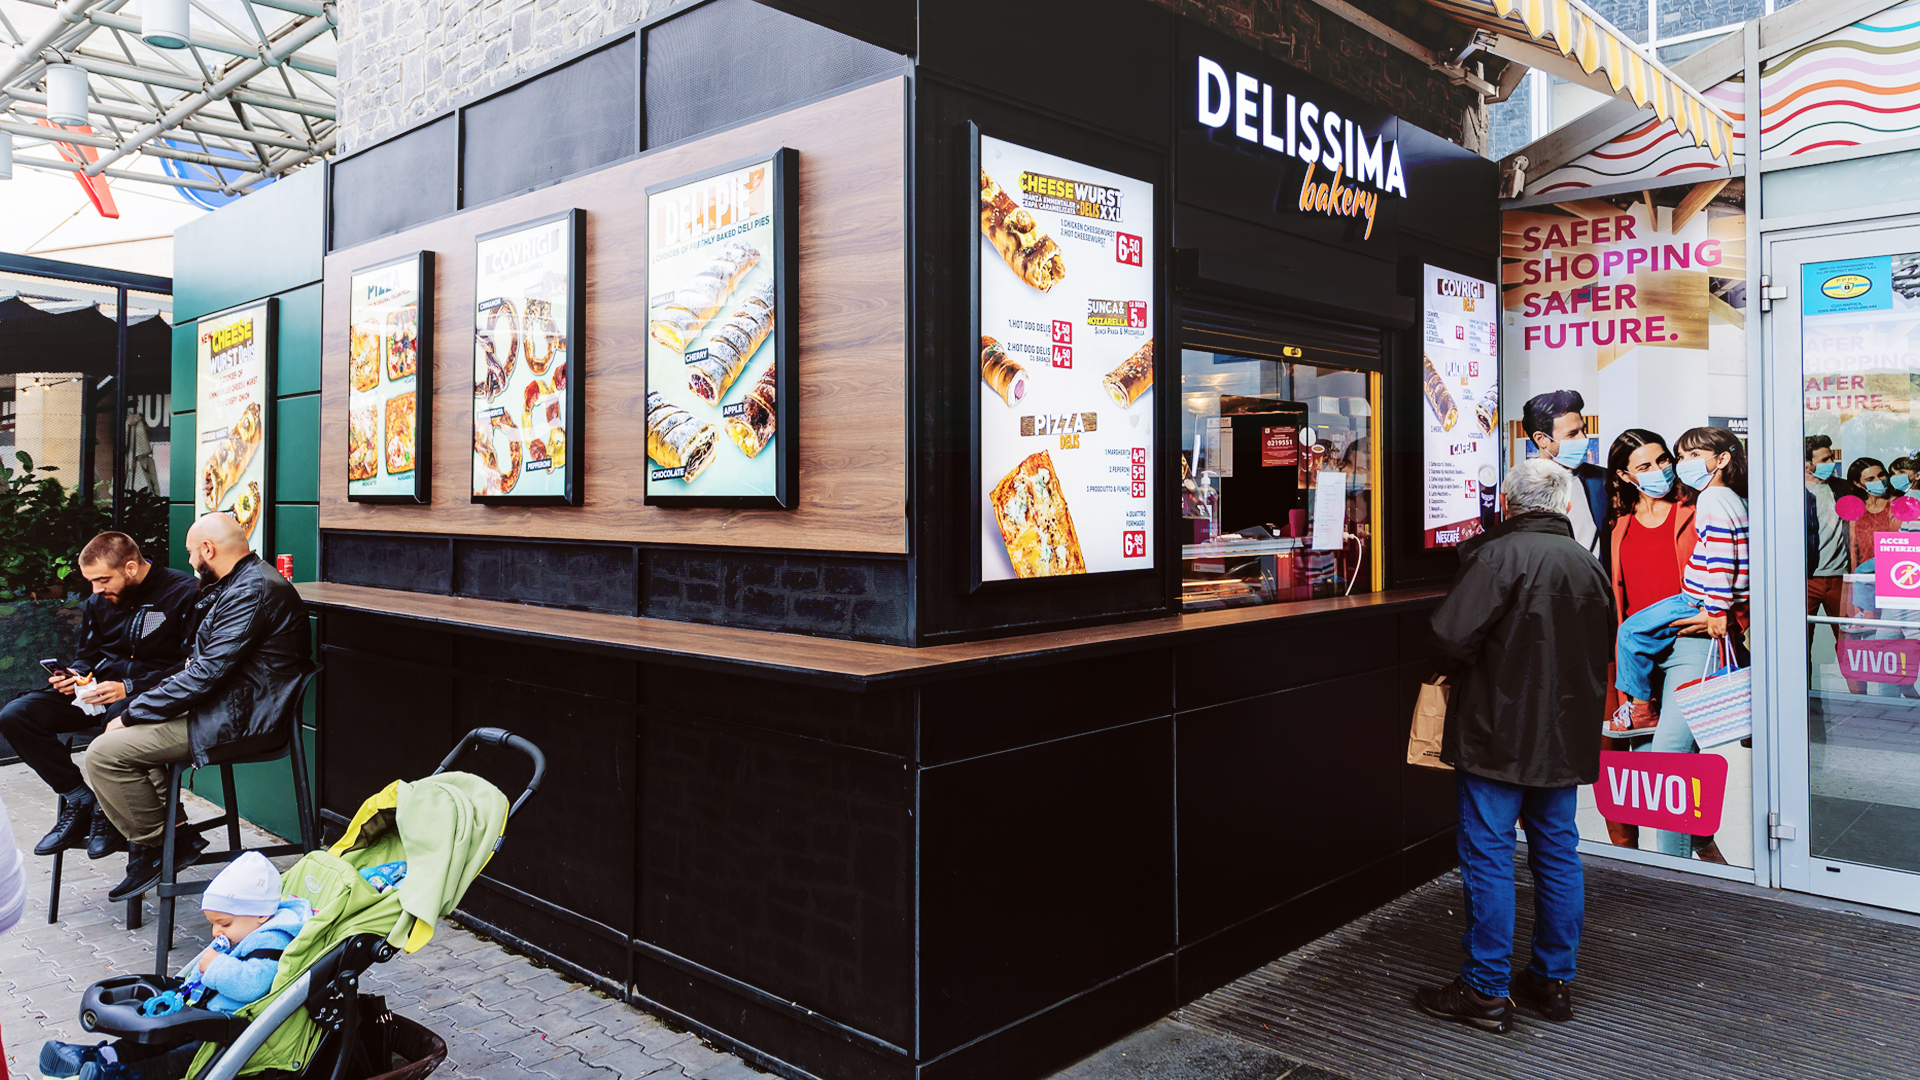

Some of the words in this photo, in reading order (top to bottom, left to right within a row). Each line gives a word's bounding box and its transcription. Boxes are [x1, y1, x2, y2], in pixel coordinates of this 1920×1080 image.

[1199, 55, 1407, 198] DELISSIMA
[665, 187, 710, 248] DELI
[716, 170, 751, 231] PIE
[1299, 159, 1377, 240] bakery
[1080, 201, 1100, 218] DELIS
[1100, 205, 1123, 222] XXL
[656, 248, 680, 262] CHOICES
[681, 244, 689, 254] OF
[690, 236, 715, 251] FRESHLY
[716, 228, 737, 242] BAKED
[737, 222, 754, 235] DELI
[754, 215, 770, 229] PIES
[1074, 231, 1106, 245] CHEESEWURST
[1084, 224, 1115, 238] CHEESEWURST
[1522, 214, 1637, 253] SAFER
[492, 230, 552, 273] COVRIGI
[1522, 239, 1722, 285] SHOPPING
[522, 261, 543, 274] CLASSICS
[1442, 279, 1481, 298] COVRIGI
[1522, 283, 1637, 318] SAFER
[1024, 321, 1036, 331] DOG
[1036, 323, 1051, 333] DELIS
[1086, 317, 1128, 326] MOZZARELLA
[1131, 308, 1138, 327] 5
[212, 318, 253, 353] CHEESE
[1524, 315, 1679, 351] FUTURE.
[685, 350, 708, 363] CHERRY
[1024, 344, 1036, 354] DOG
[1036, 346, 1051, 356] DELIS
[209, 347, 239, 376] WURST
[724, 404, 743, 415] APPLE
[1034, 413, 1085, 435] PIZZA
[1060, 434, 1080, 449] DELIS
[527, 459, 551, 470] PEPPERONI
[652, 468, 685, 479] CHOCOLATE
[1880, 537, 1909, 545] ACCES
[1847, 648, 1907, 675] VIVO!
[1606, 766, 1702, 819] VIVO!
